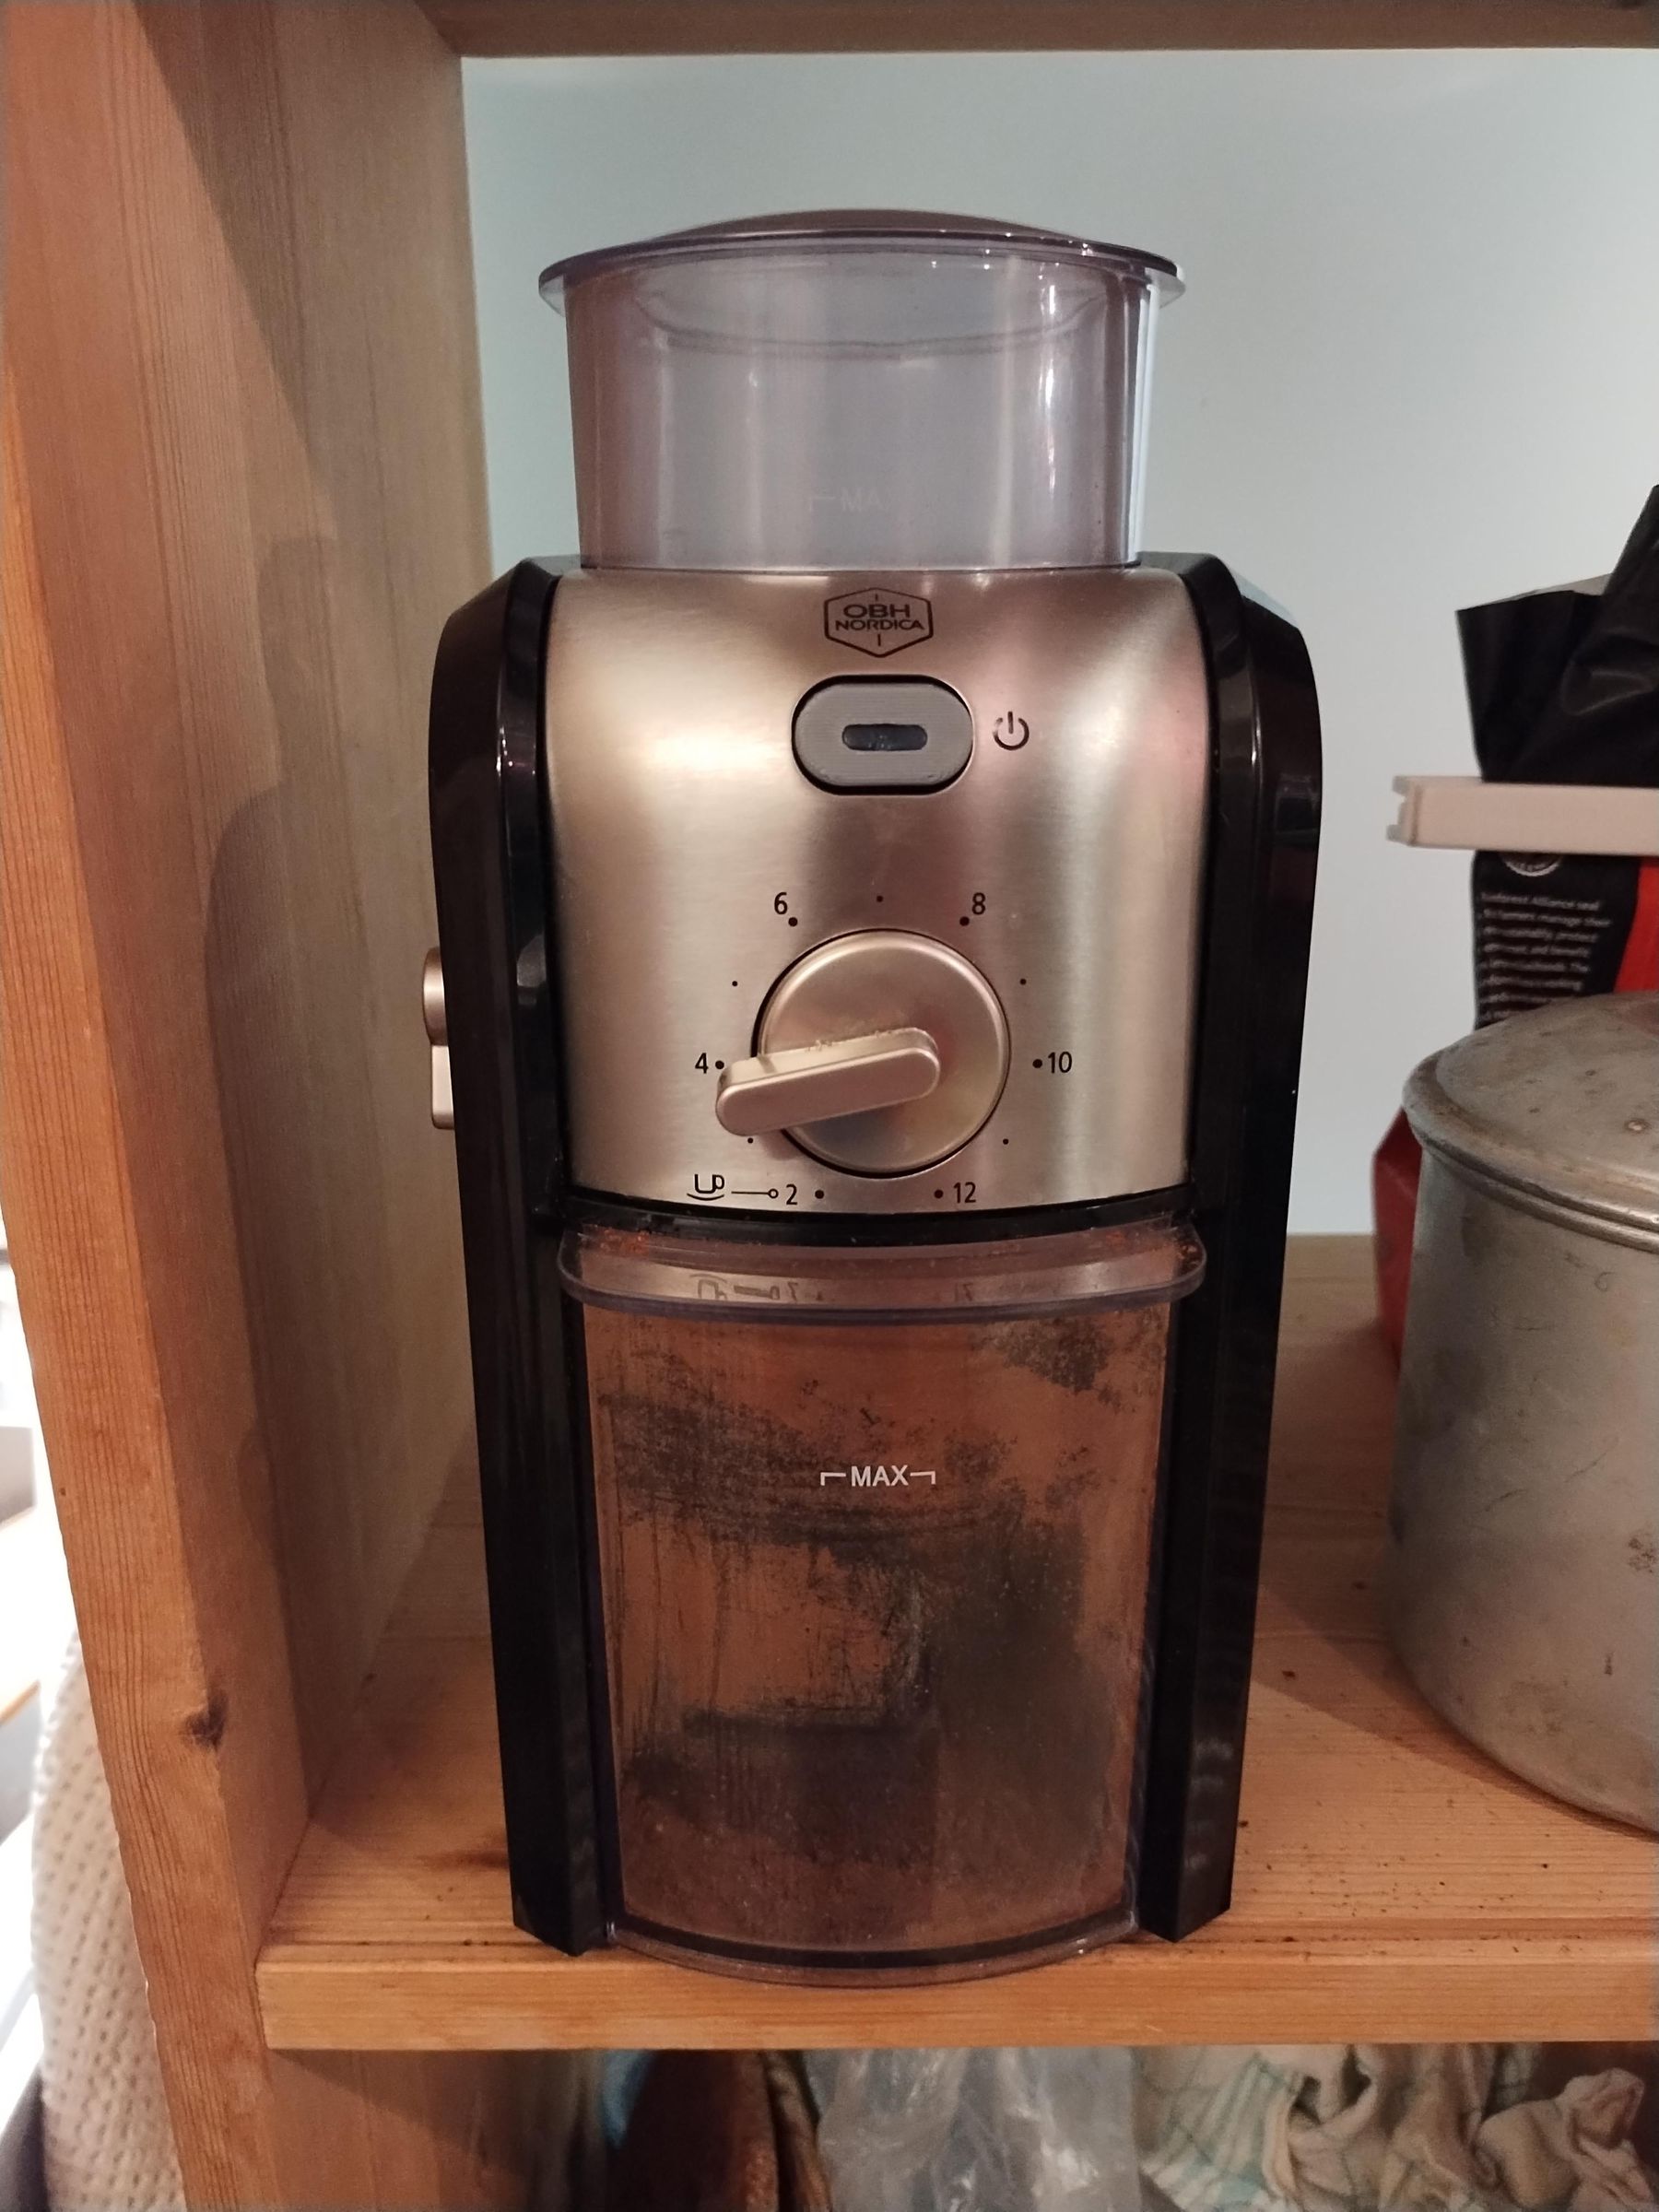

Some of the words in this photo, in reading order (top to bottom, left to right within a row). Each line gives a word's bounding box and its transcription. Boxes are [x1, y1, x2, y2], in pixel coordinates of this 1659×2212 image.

[842, 604, 911, 618] OBH
[835, 618, 925, 631] NORDICA
[773, 891, 788, 915] 6
[971, 892, 986, 915] 8
[694, 1052, 709, 1075] 4
[1047, 1051, 1073, 1074] 10
[785, 1183, 798, 1206] 2
[953, 1181, 976, 1204] 12
[851, 1465, 909, 1487] MAX
